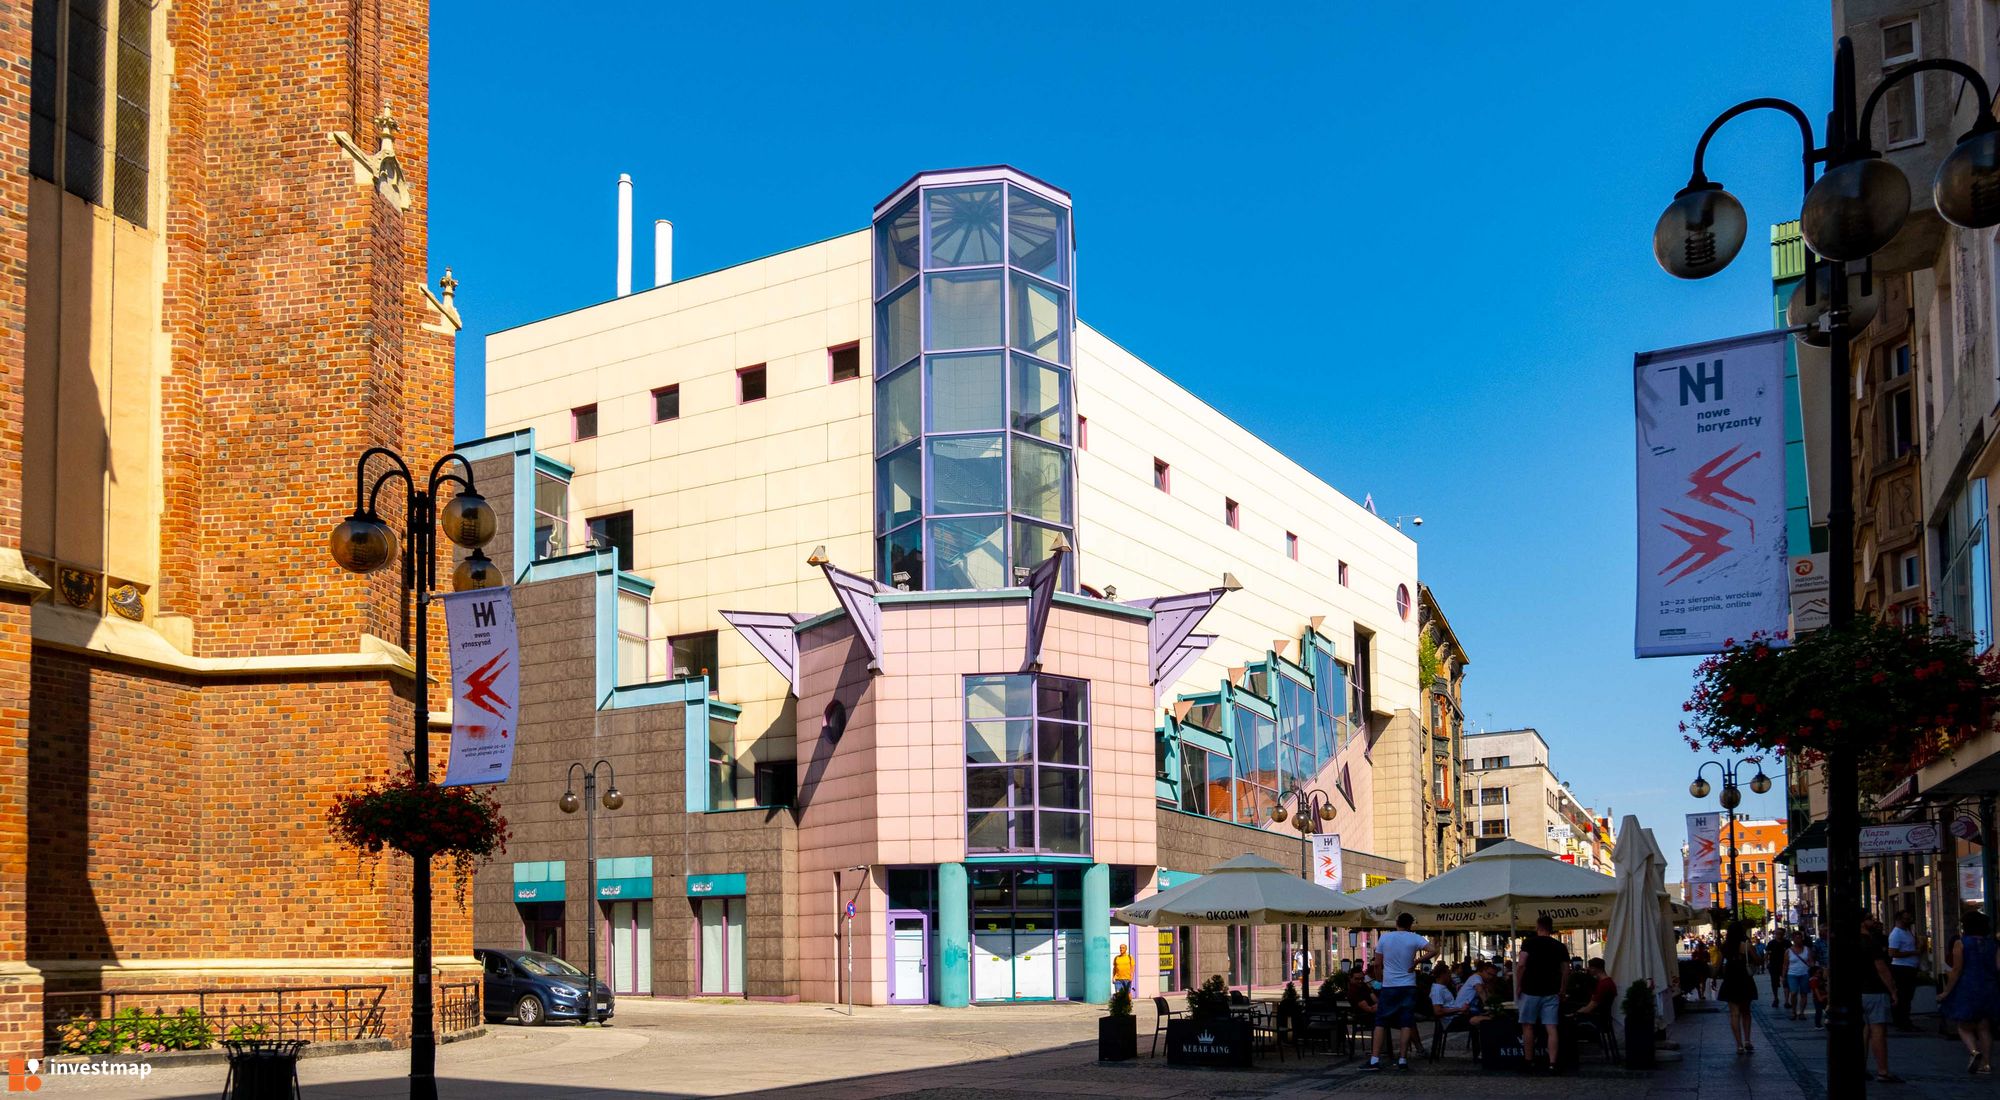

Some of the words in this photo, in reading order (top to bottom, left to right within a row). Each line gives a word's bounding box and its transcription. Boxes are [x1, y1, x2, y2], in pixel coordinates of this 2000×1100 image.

[1680, 359, 1723, 406] NH
[1697, 408, 1731, 420] nowe
[1697, 416, 1762, 433] horyzonty
[1688, 594, 1723, 604] sierpnia,
[1725, 591, 1762, 600] wrocław
[1688, 603, 1723, 612] sierpnia,
[1725, 601, 1752, 609] online
[1206, 910, 1250, 920] OKOCIM
[1182, 1045, 1208, 1053] KEBAB
[1500, 1048, 1525, 1056] KEBA
